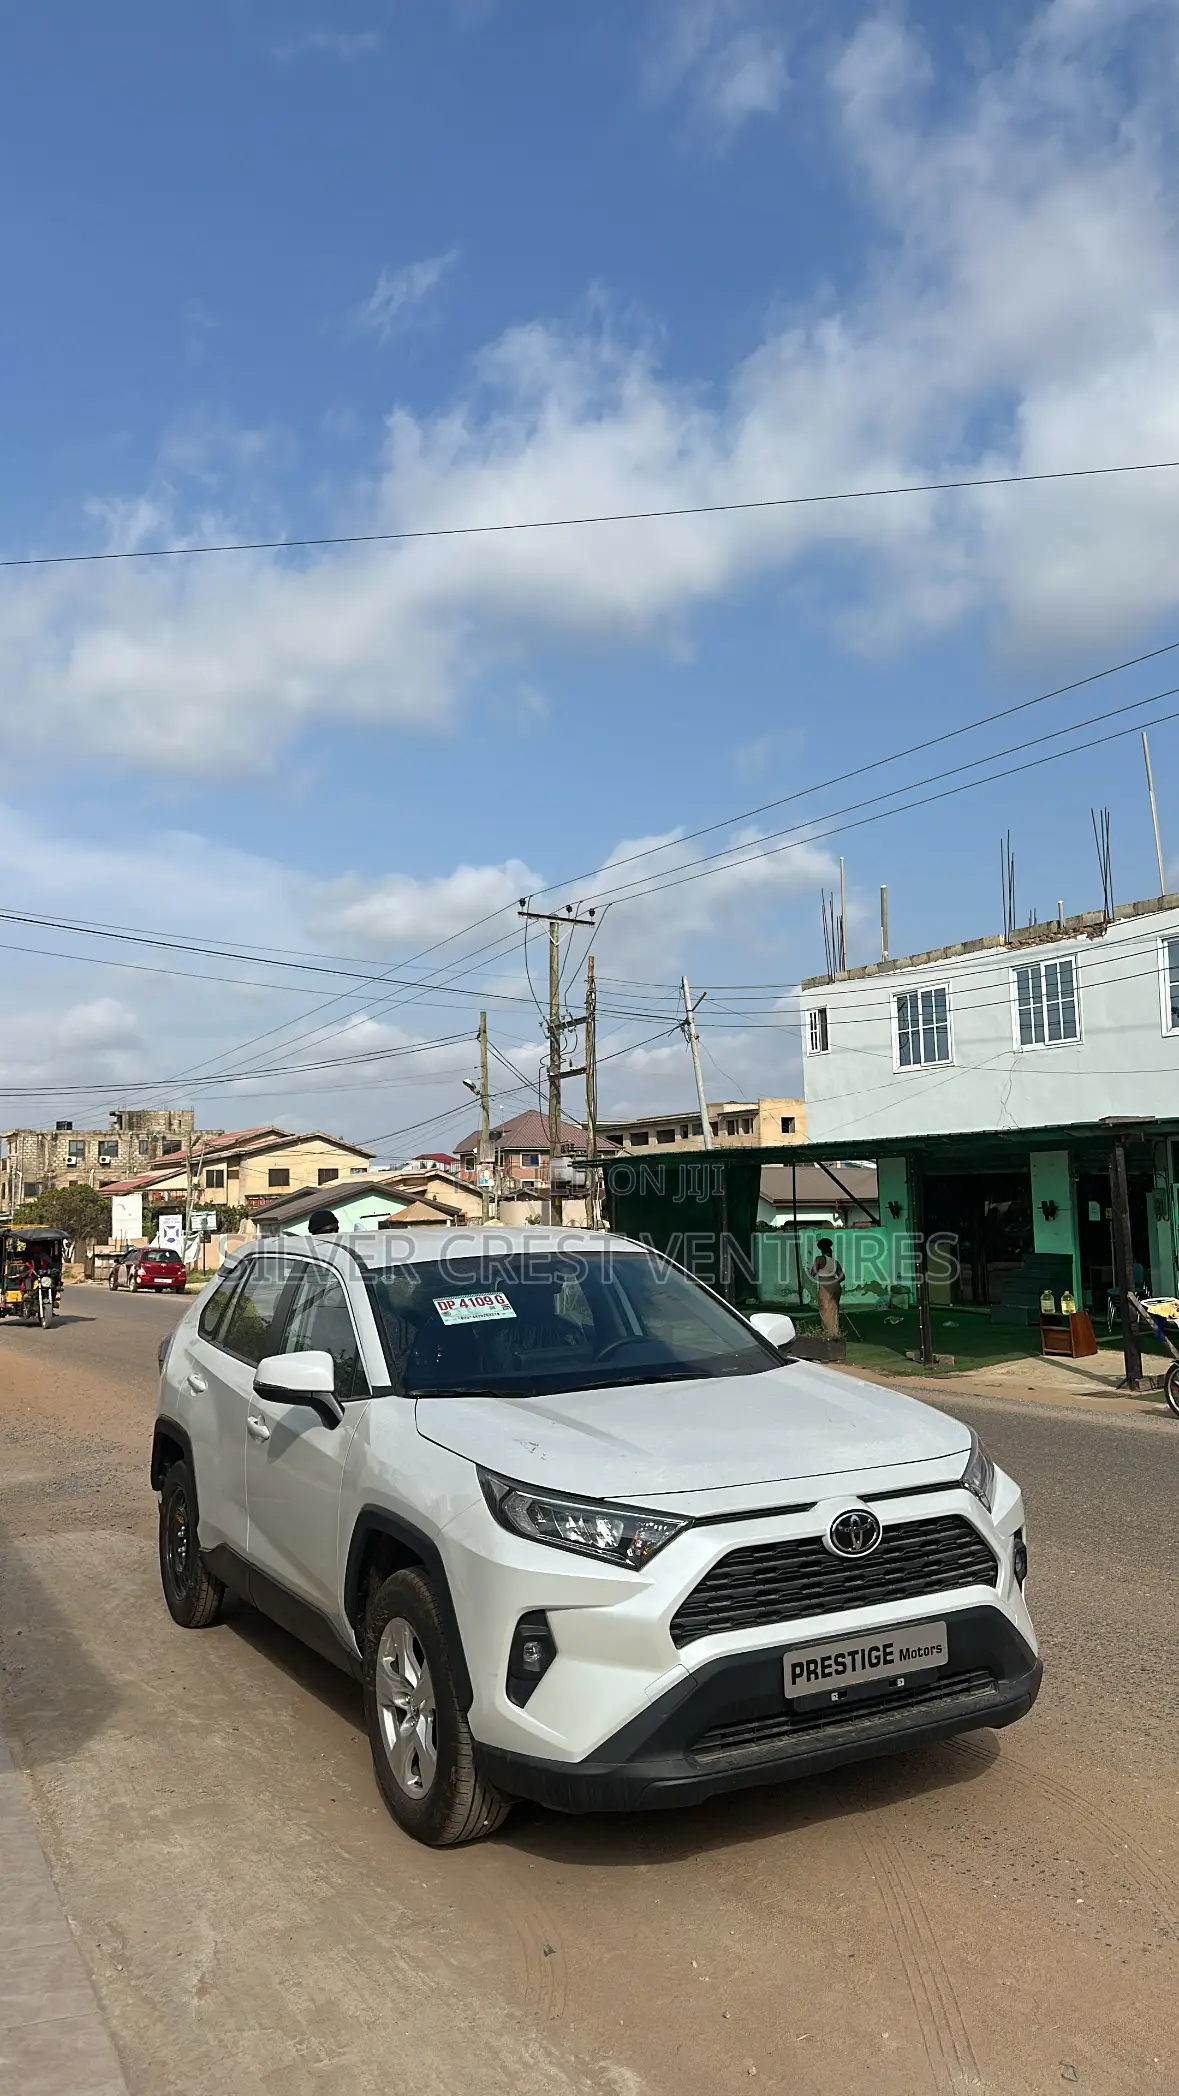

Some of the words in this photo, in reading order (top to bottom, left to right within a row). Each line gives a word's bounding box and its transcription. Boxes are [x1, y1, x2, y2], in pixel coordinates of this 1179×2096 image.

[437, 1300, 456, 1311] DP
[460, 1297, 494, 1309] 4109
[494, 1295, 505, 1304] G
[791, 1643, 895, 1685] PRESTIGE
[899, 1644, 943, 1662] Motors
